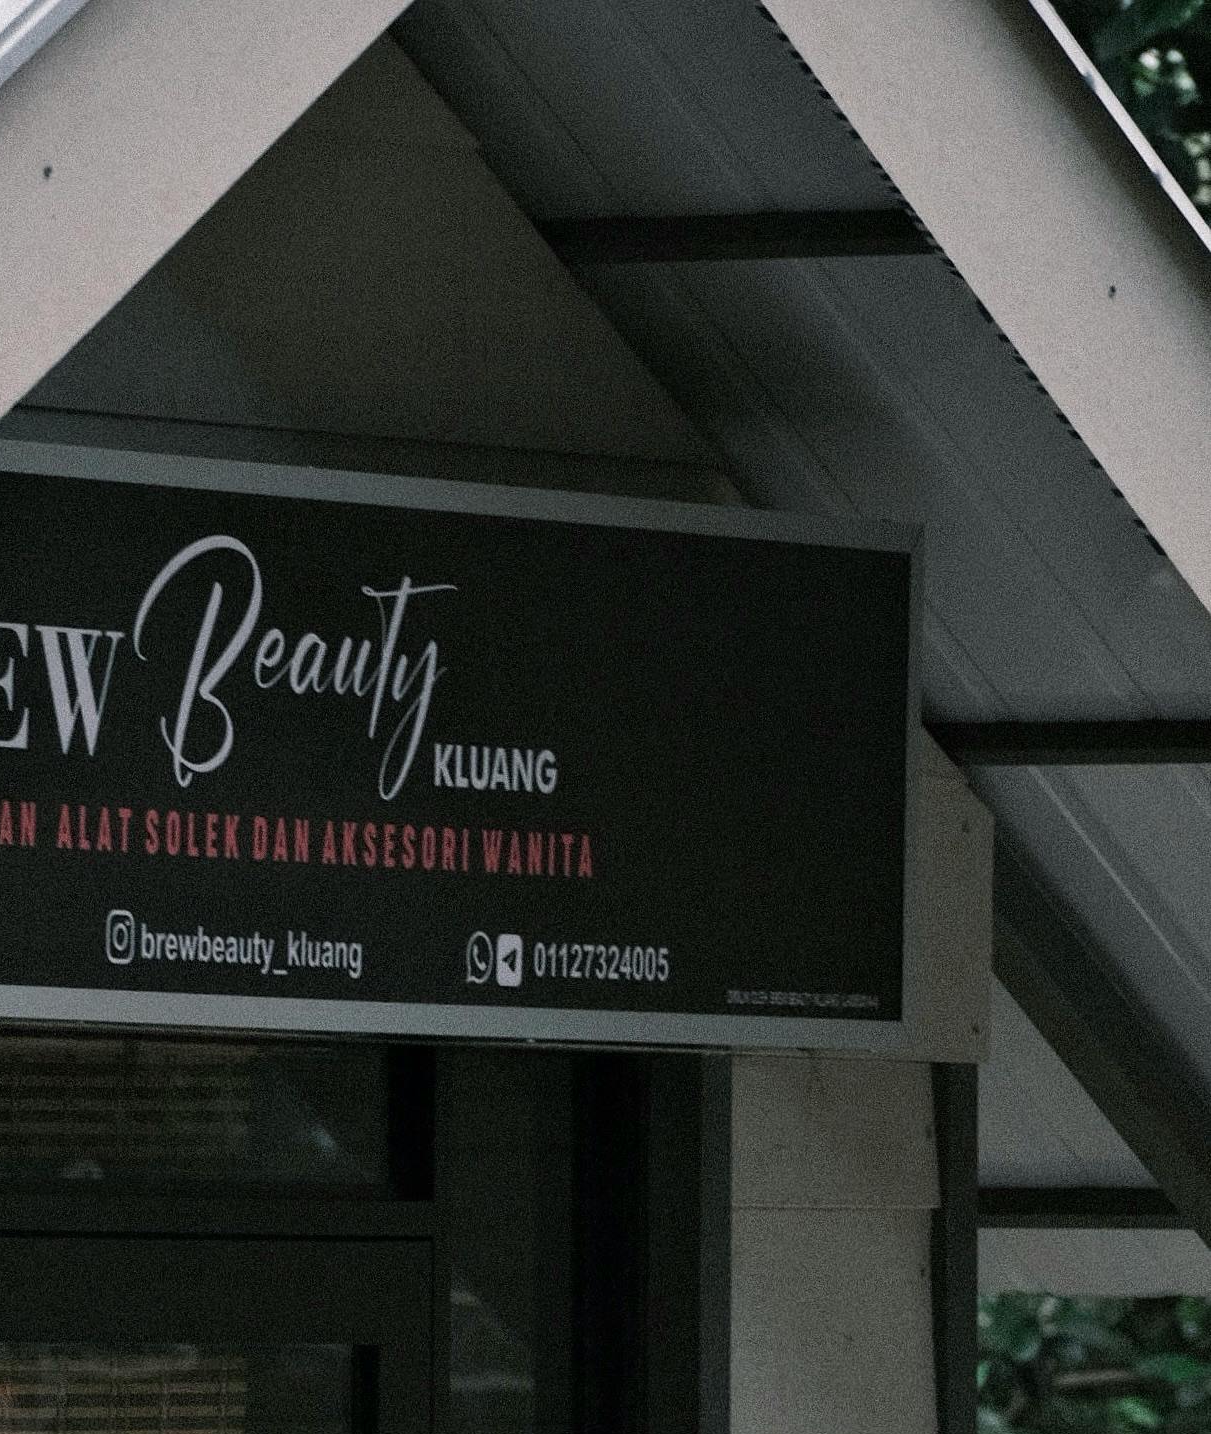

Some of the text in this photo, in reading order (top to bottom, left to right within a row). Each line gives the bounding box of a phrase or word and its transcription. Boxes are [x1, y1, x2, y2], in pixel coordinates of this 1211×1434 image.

[133, 535, 460, 800] Beauty
[434, 743, 557, 793] KLUANG
[57, 804, 132, 852] ALAT
[145, 809, 239, 858] SOLEK
[253, 816, 309, 862] DAN
[322, 821, 469, 871] AKSESORI
[482, 830, 592, 877] WANITA
[141, 923, 362, 979] brewbeauty_kluang
[534, 942, 669, 981] 01127324005
